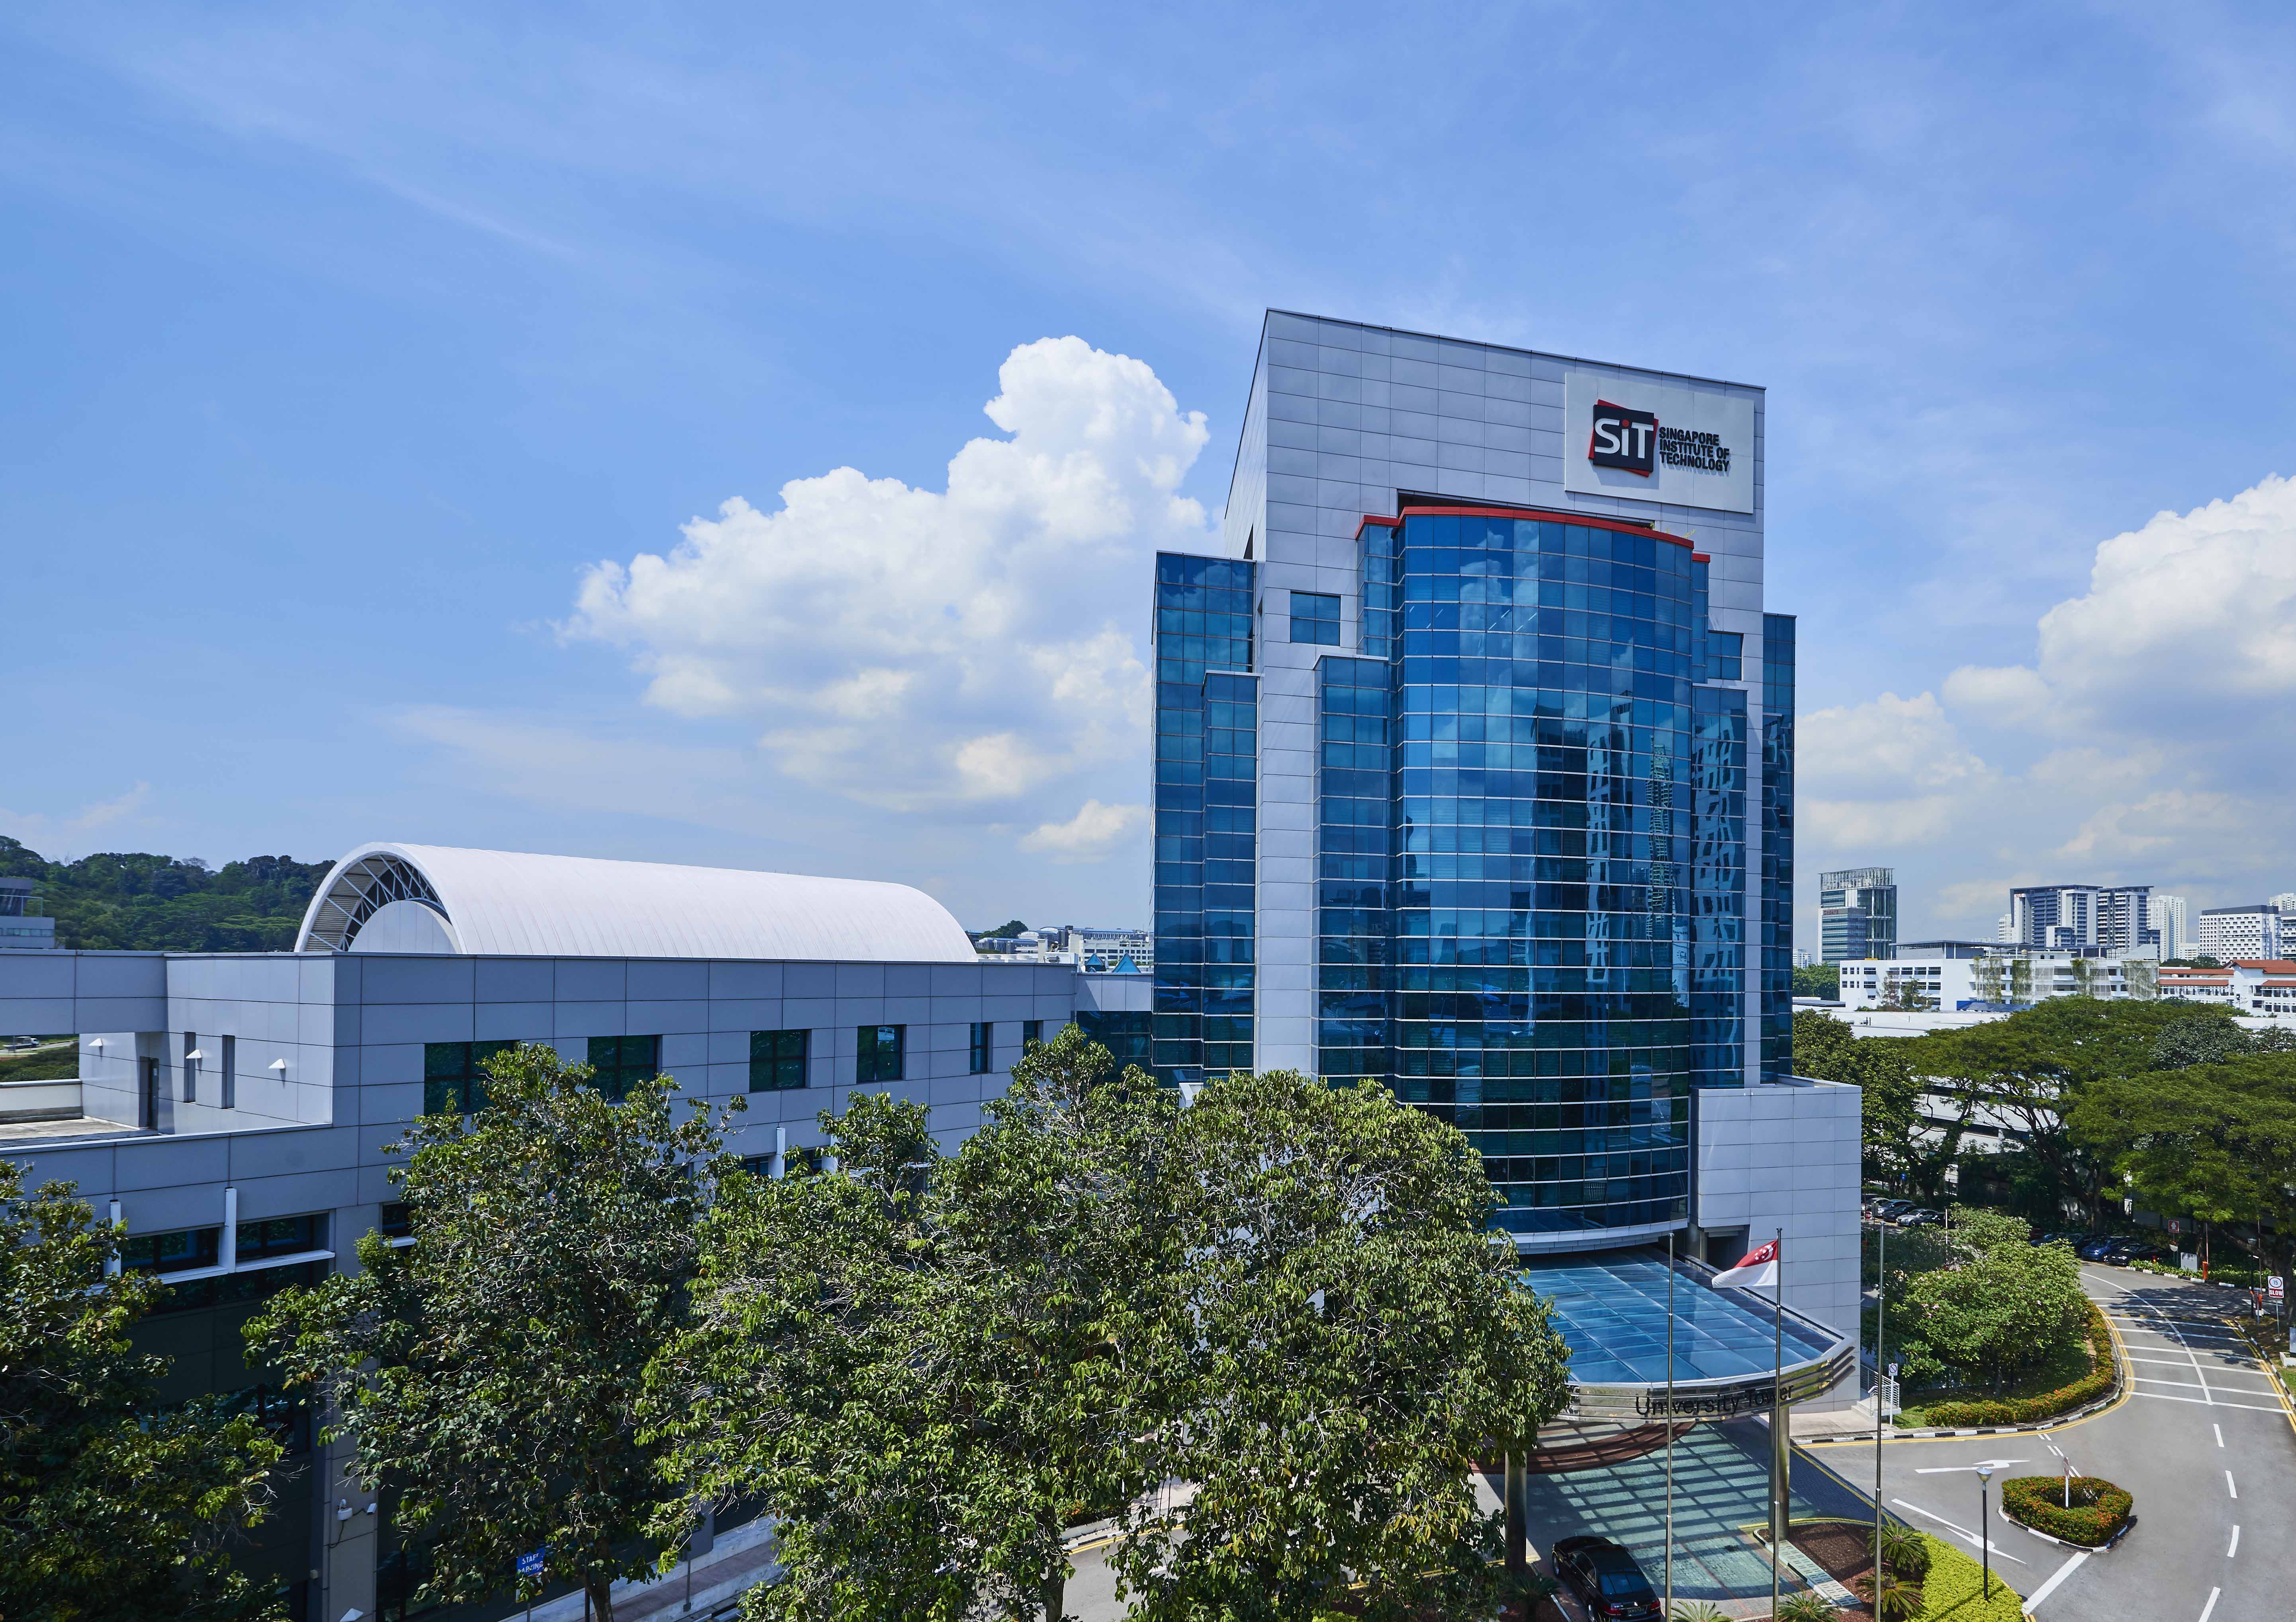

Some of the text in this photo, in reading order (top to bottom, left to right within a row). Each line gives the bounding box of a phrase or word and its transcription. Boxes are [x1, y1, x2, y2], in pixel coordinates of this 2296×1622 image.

[1659, 427, 1719, 446] SINGAPORE
[1660, 439, 1730, 459] INSTITUTE OF
[1660, 452, 1730, 472] TECHNOLOGY
[1636, 1393, 1740, 1415] University
[518, 1561, 543, 1573] ARING
